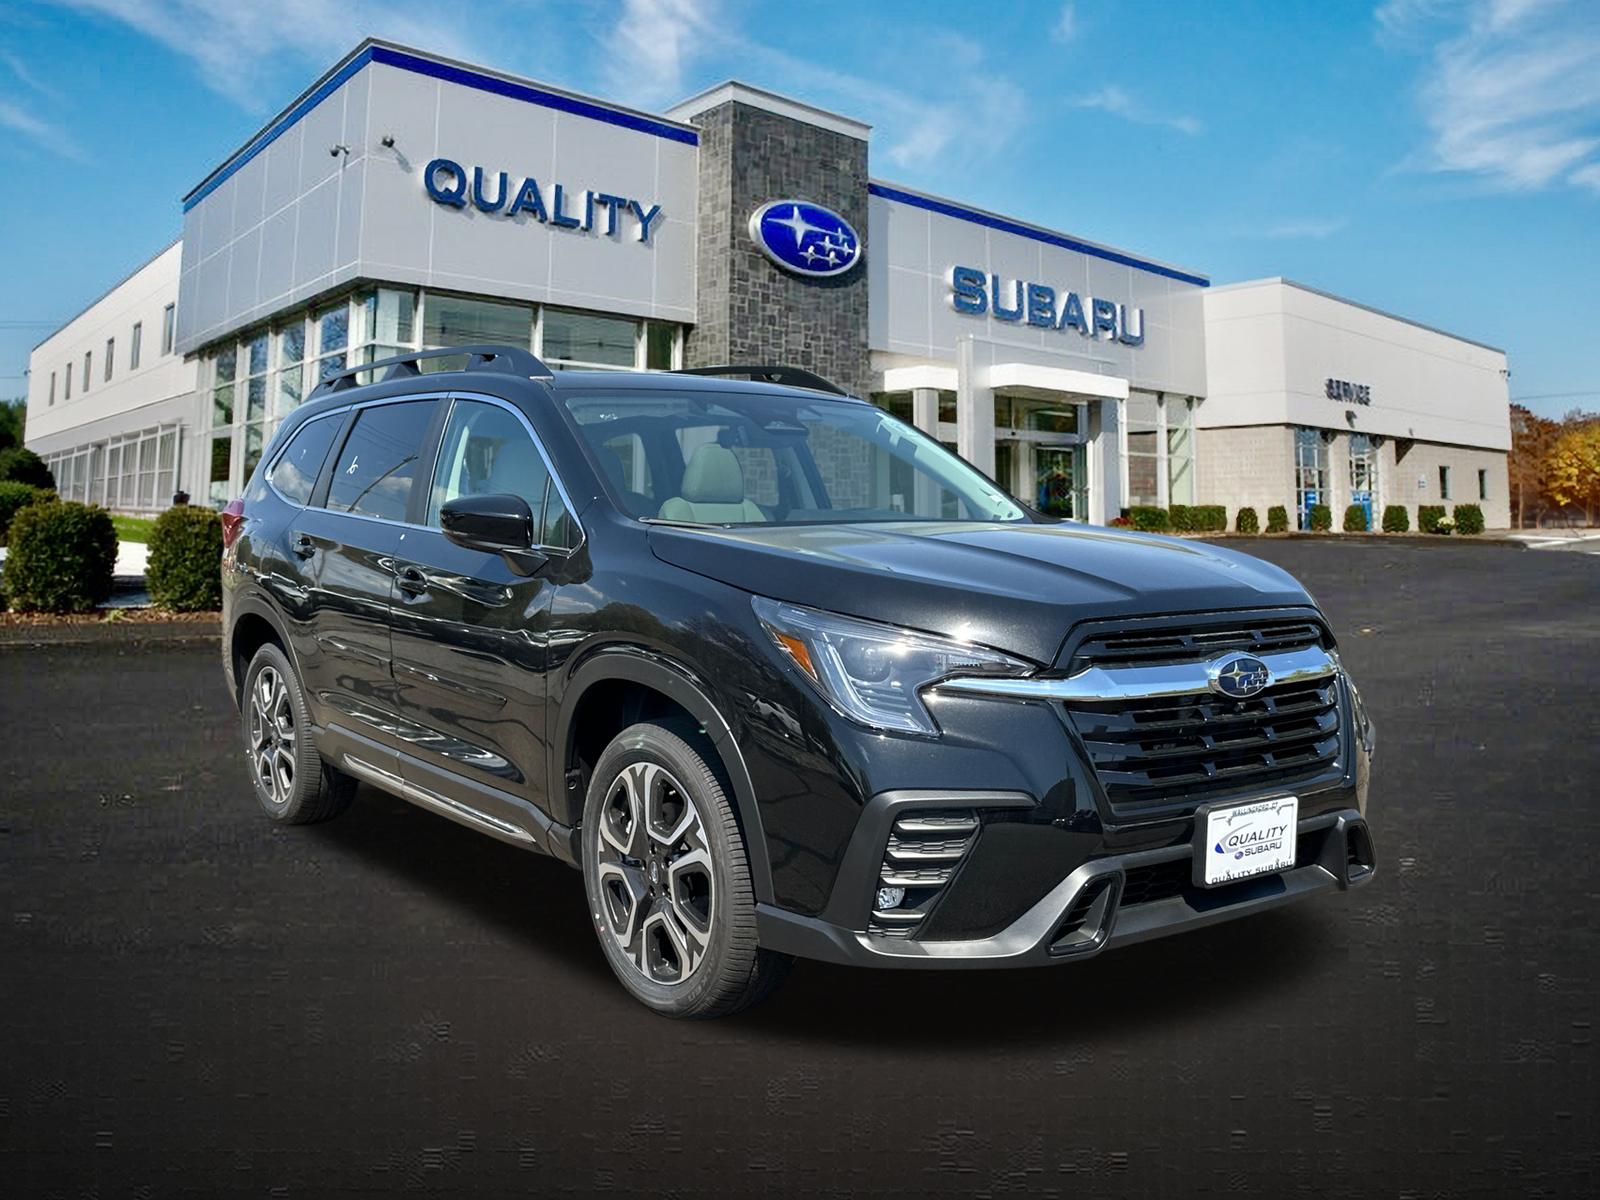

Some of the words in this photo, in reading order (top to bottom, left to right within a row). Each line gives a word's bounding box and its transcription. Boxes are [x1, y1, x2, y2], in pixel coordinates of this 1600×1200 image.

[424, 158, 661, 242] QUALITY
[951, 265, 1144, 346] SUBARU
[1228, 825, 1287, 847] QUALITY
[1244, 841, 1282, 856] SUBARU
